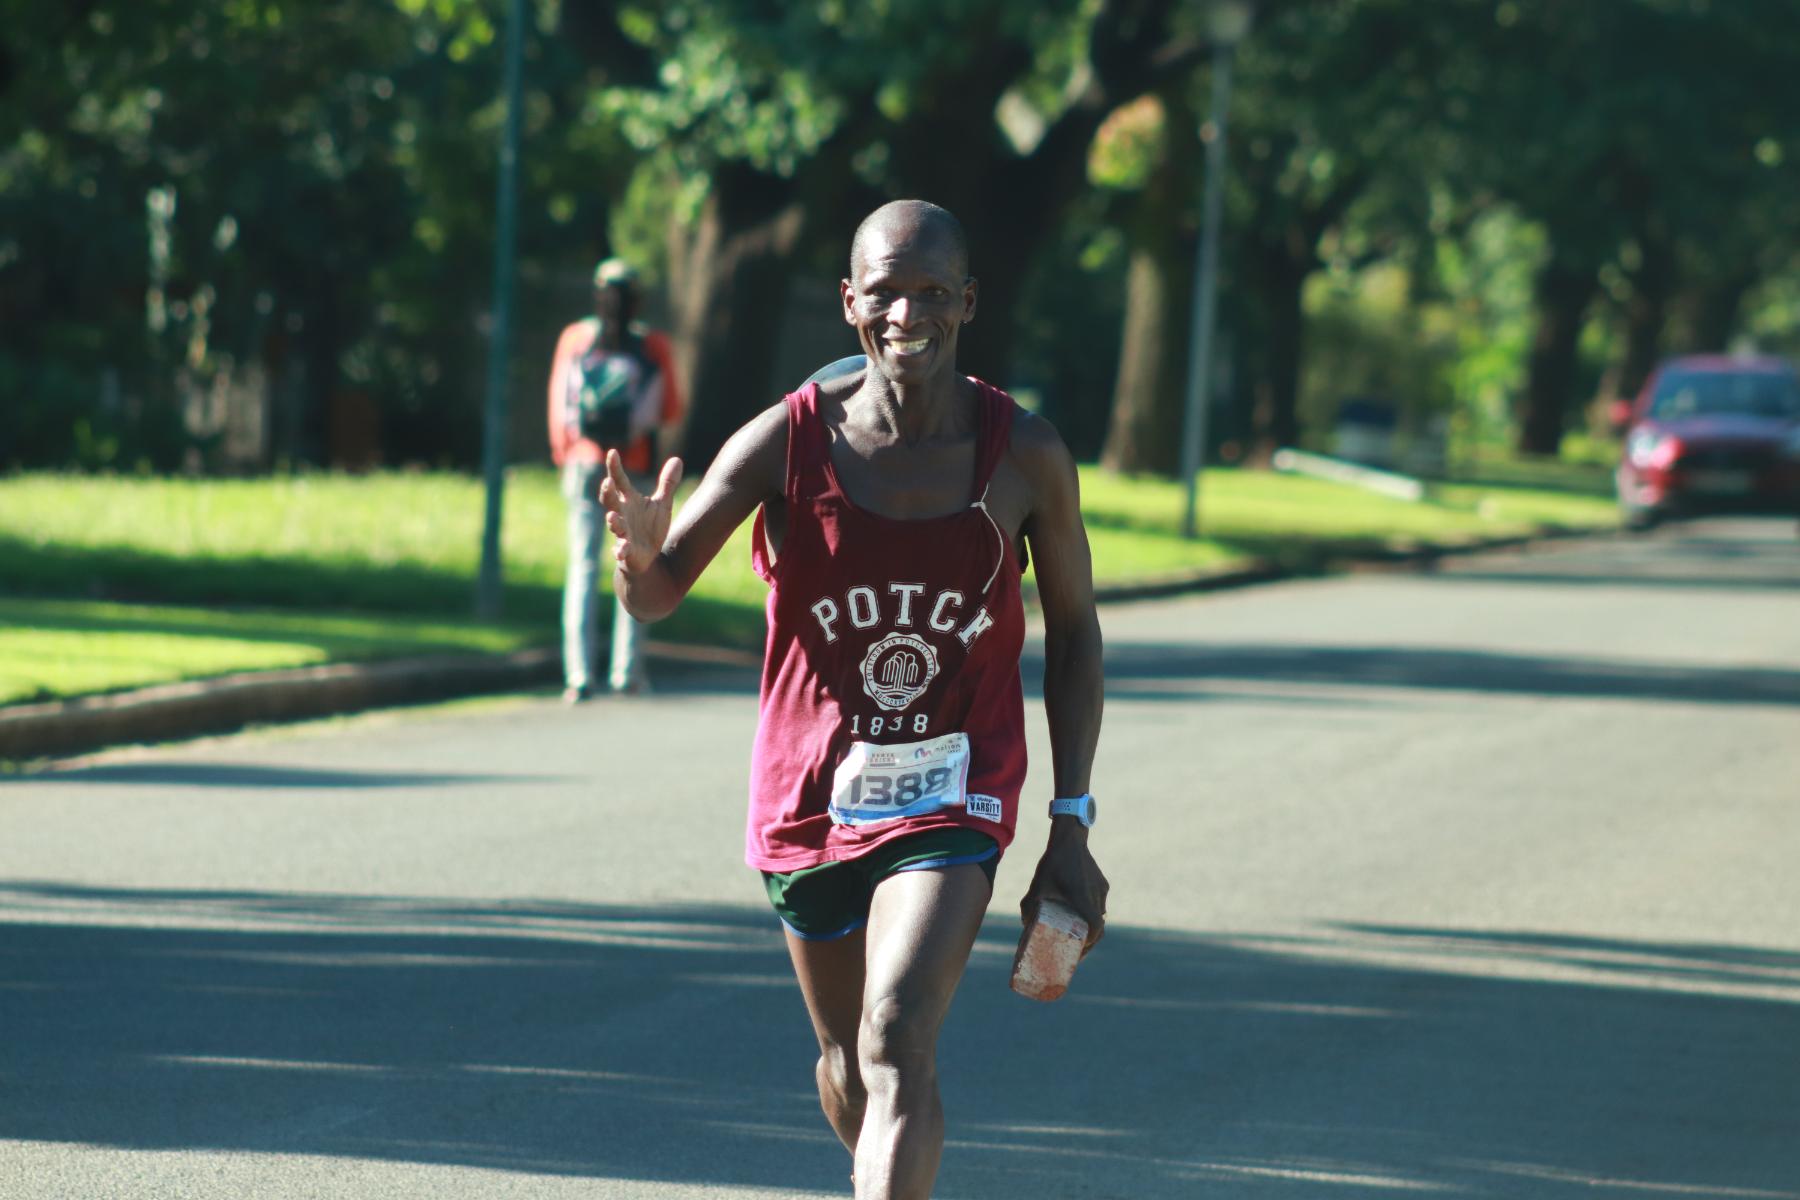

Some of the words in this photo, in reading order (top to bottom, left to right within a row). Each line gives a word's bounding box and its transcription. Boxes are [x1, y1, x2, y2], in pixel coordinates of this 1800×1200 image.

[810, 581, 995, 649] POTCH
[851, 713, 928, 735] 1838
[970, 801, 1000, 814] VARSITY
